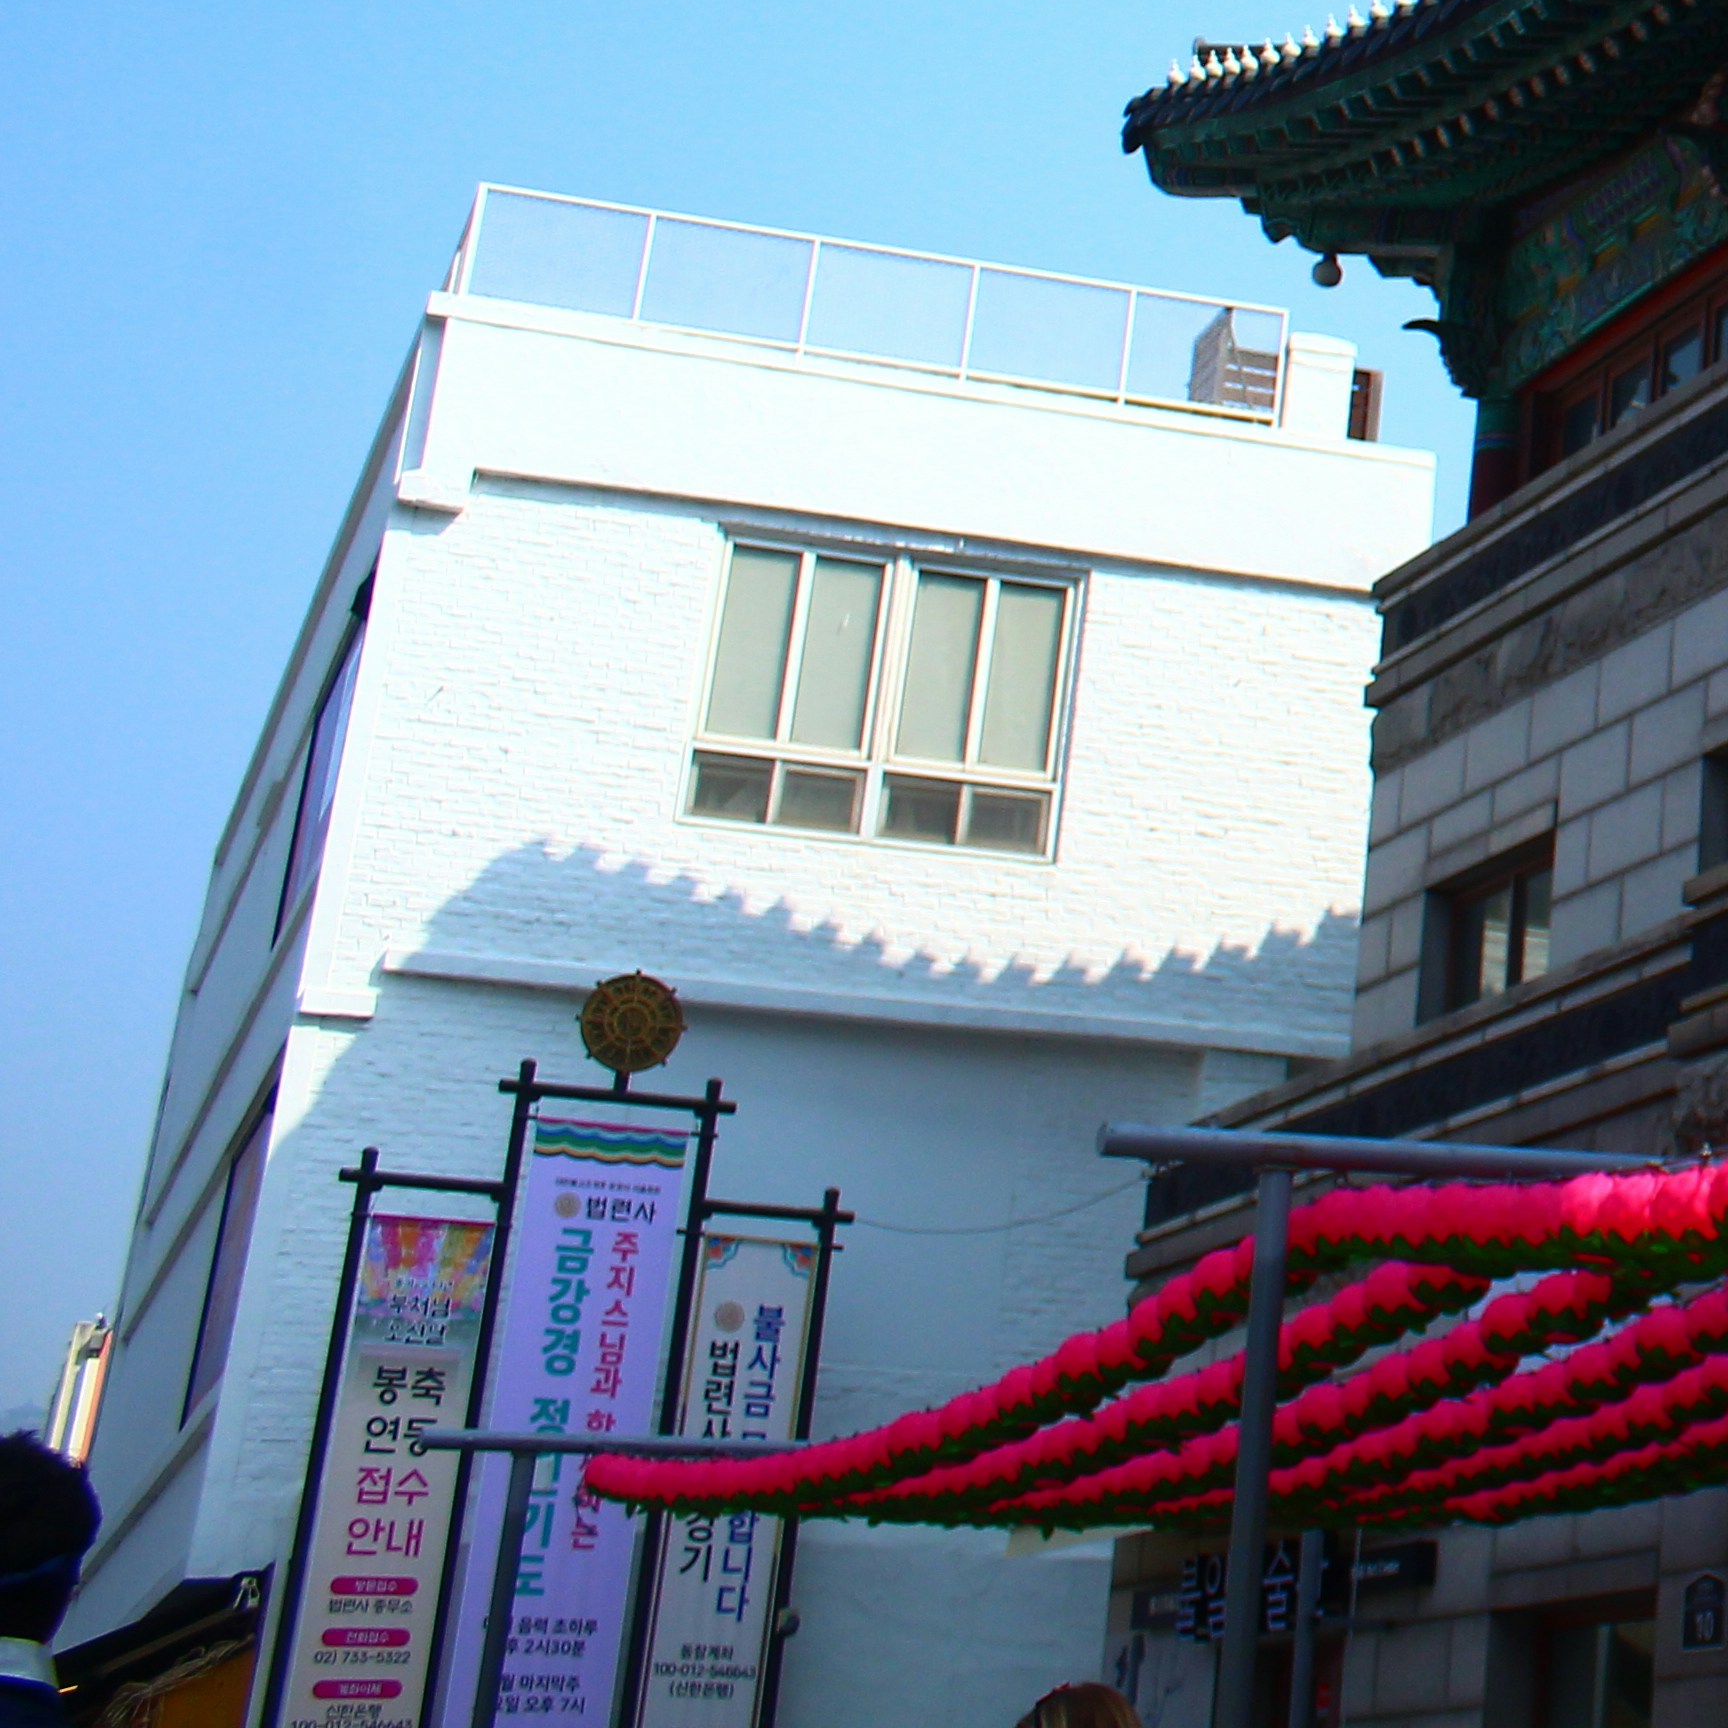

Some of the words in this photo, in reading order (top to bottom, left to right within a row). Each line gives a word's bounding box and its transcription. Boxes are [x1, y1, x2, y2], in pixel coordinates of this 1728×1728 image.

[585, 1196, 657, 1225] 법련사
[389, 1294, 453, 1319] 부처님
[541, 1228, 595, 1377] 금강경
[589, 1231, 640, 1398] 주지스님과
[742, 1303, 785, 1420] 불사금
[372, 1365, 447, 1407] 봉축
[356, 1466, 430, 1506] 접수
[345, 1518, 425, 1559] 안내
[552, 1618, 599, 1638] 초하루
[313, 1651, 338, 1665] 02)
[342, 1651, 411, 1665] 733-5322
[524, 1638, 587, 1658] 2시30분
[519, 1674, 581, 1693] 마지막주
[523, 1696, 554, 1713] 오후
[560, 1696, 586, 1714] 7시
